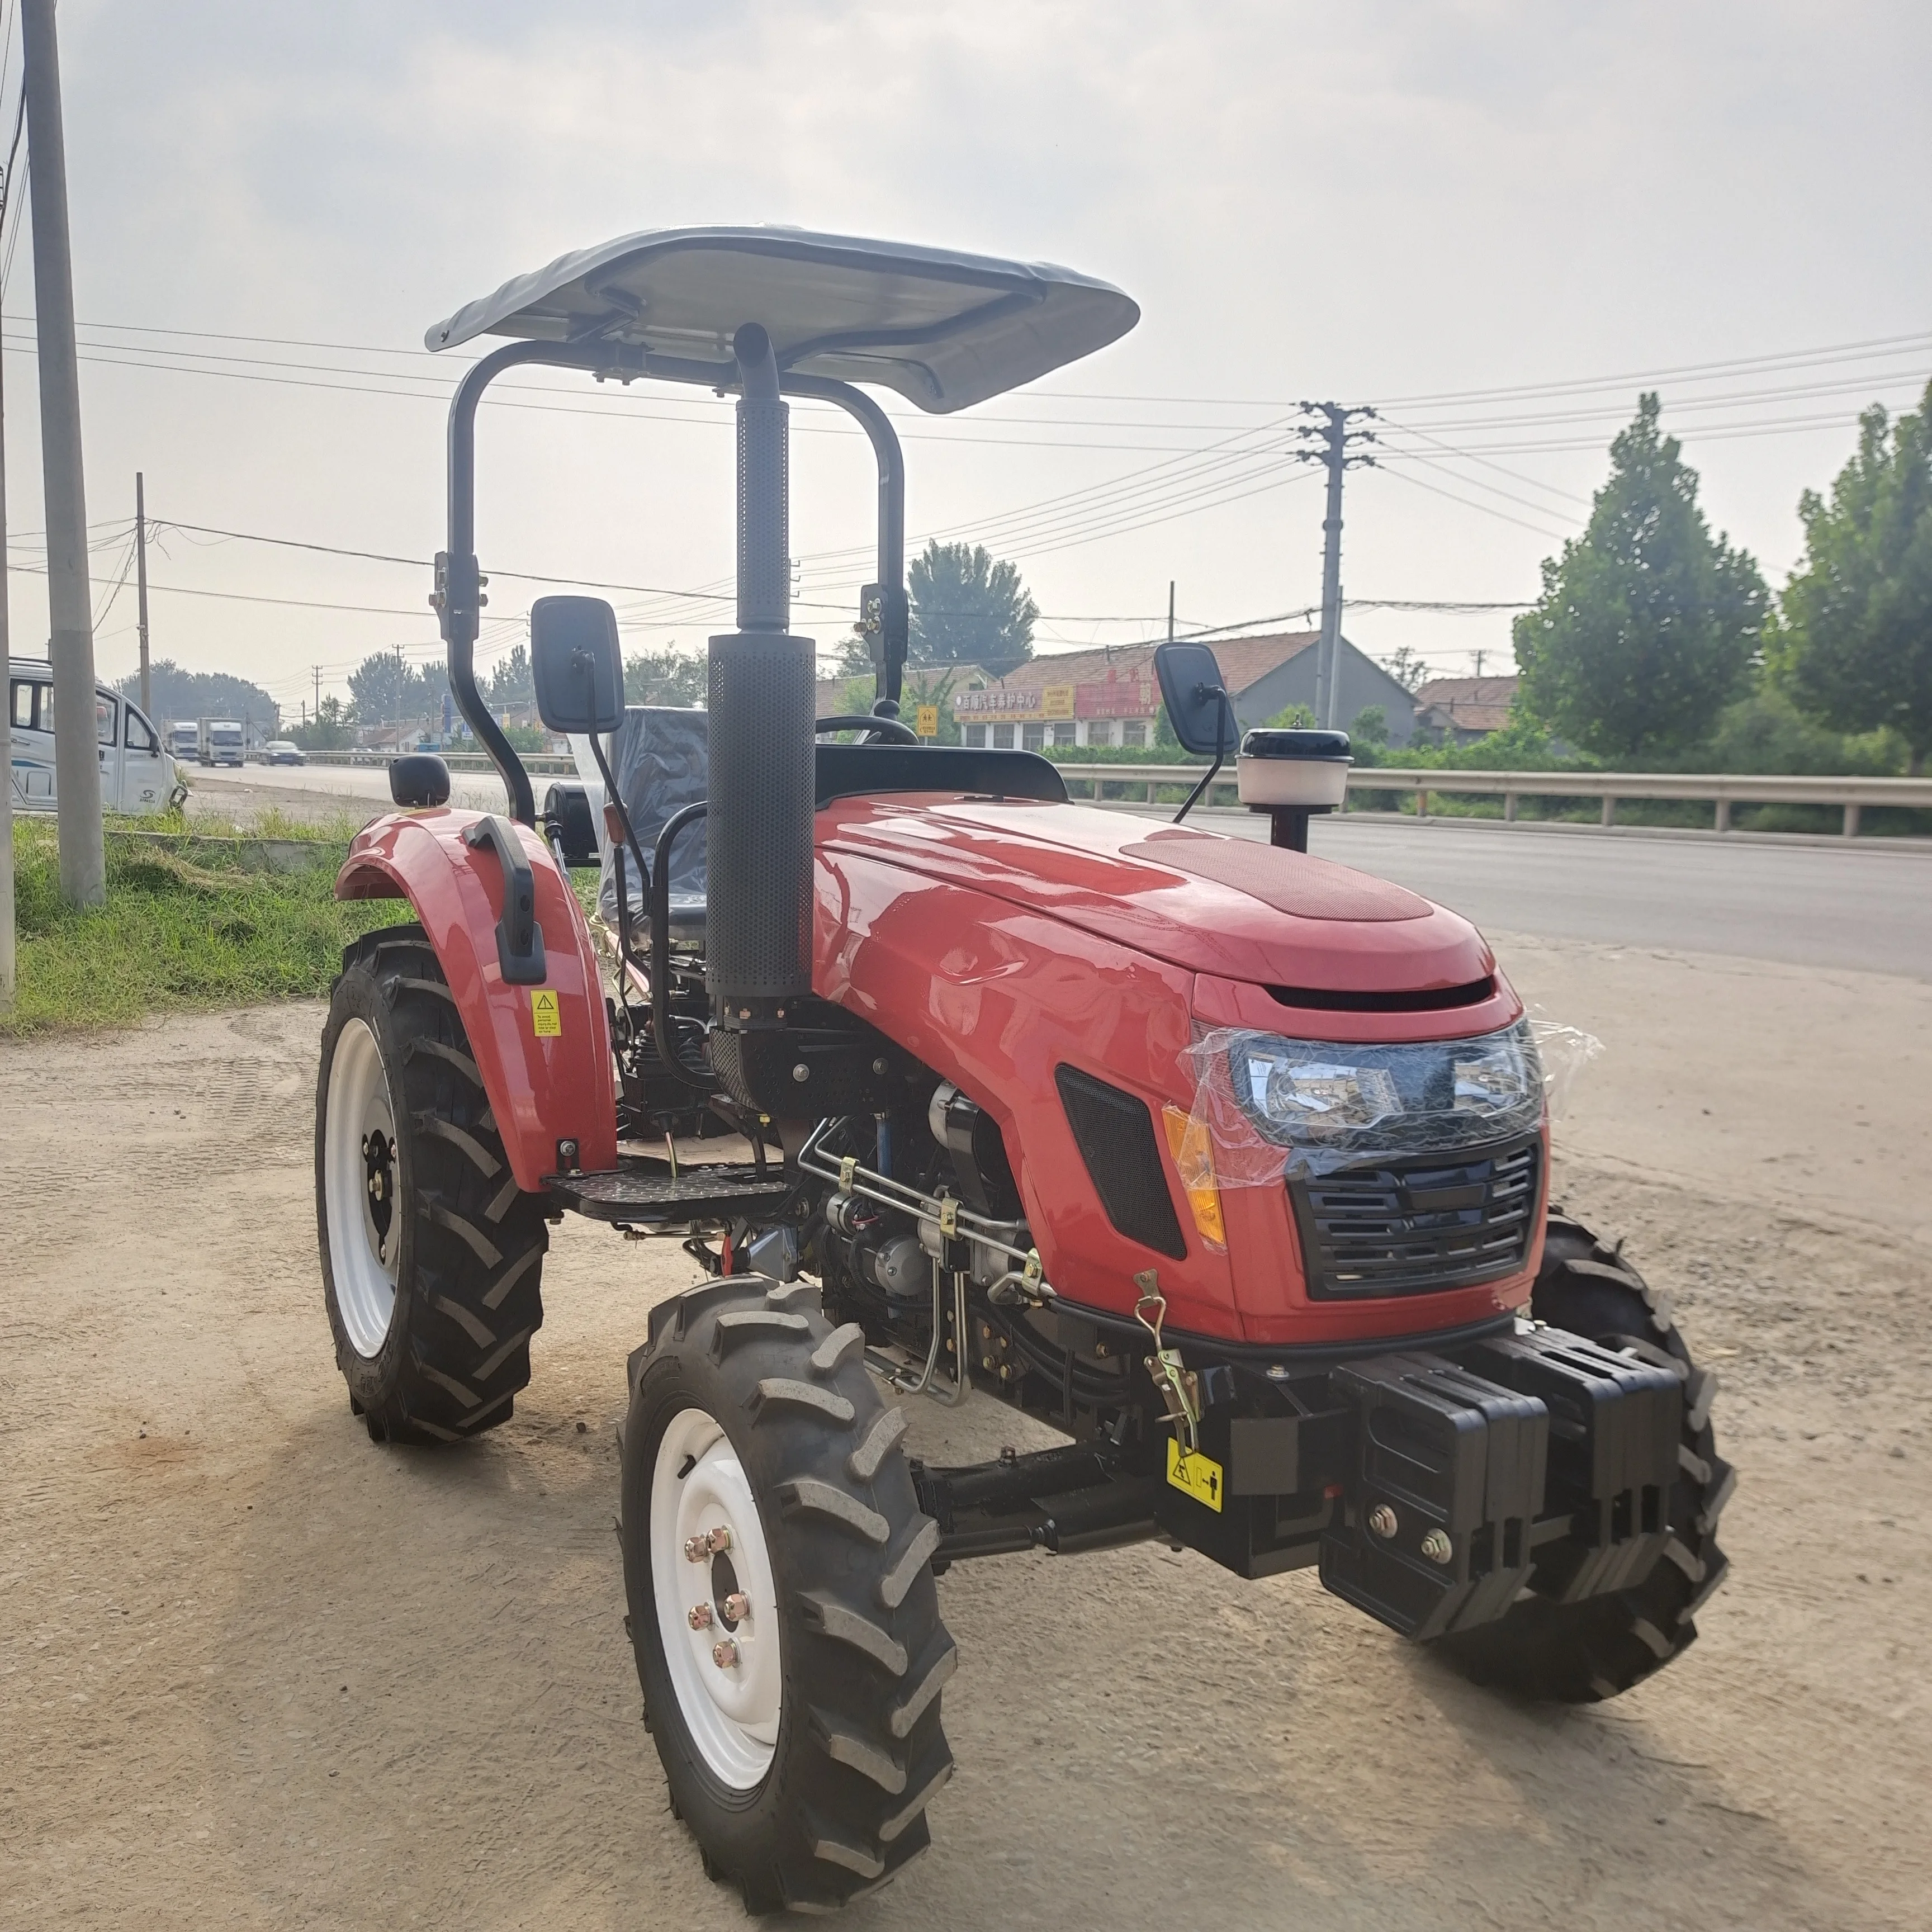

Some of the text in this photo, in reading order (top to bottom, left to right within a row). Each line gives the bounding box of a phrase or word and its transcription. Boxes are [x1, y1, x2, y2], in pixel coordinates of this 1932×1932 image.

[963, 691, 1036, 711] 百顺汽车养护中心
